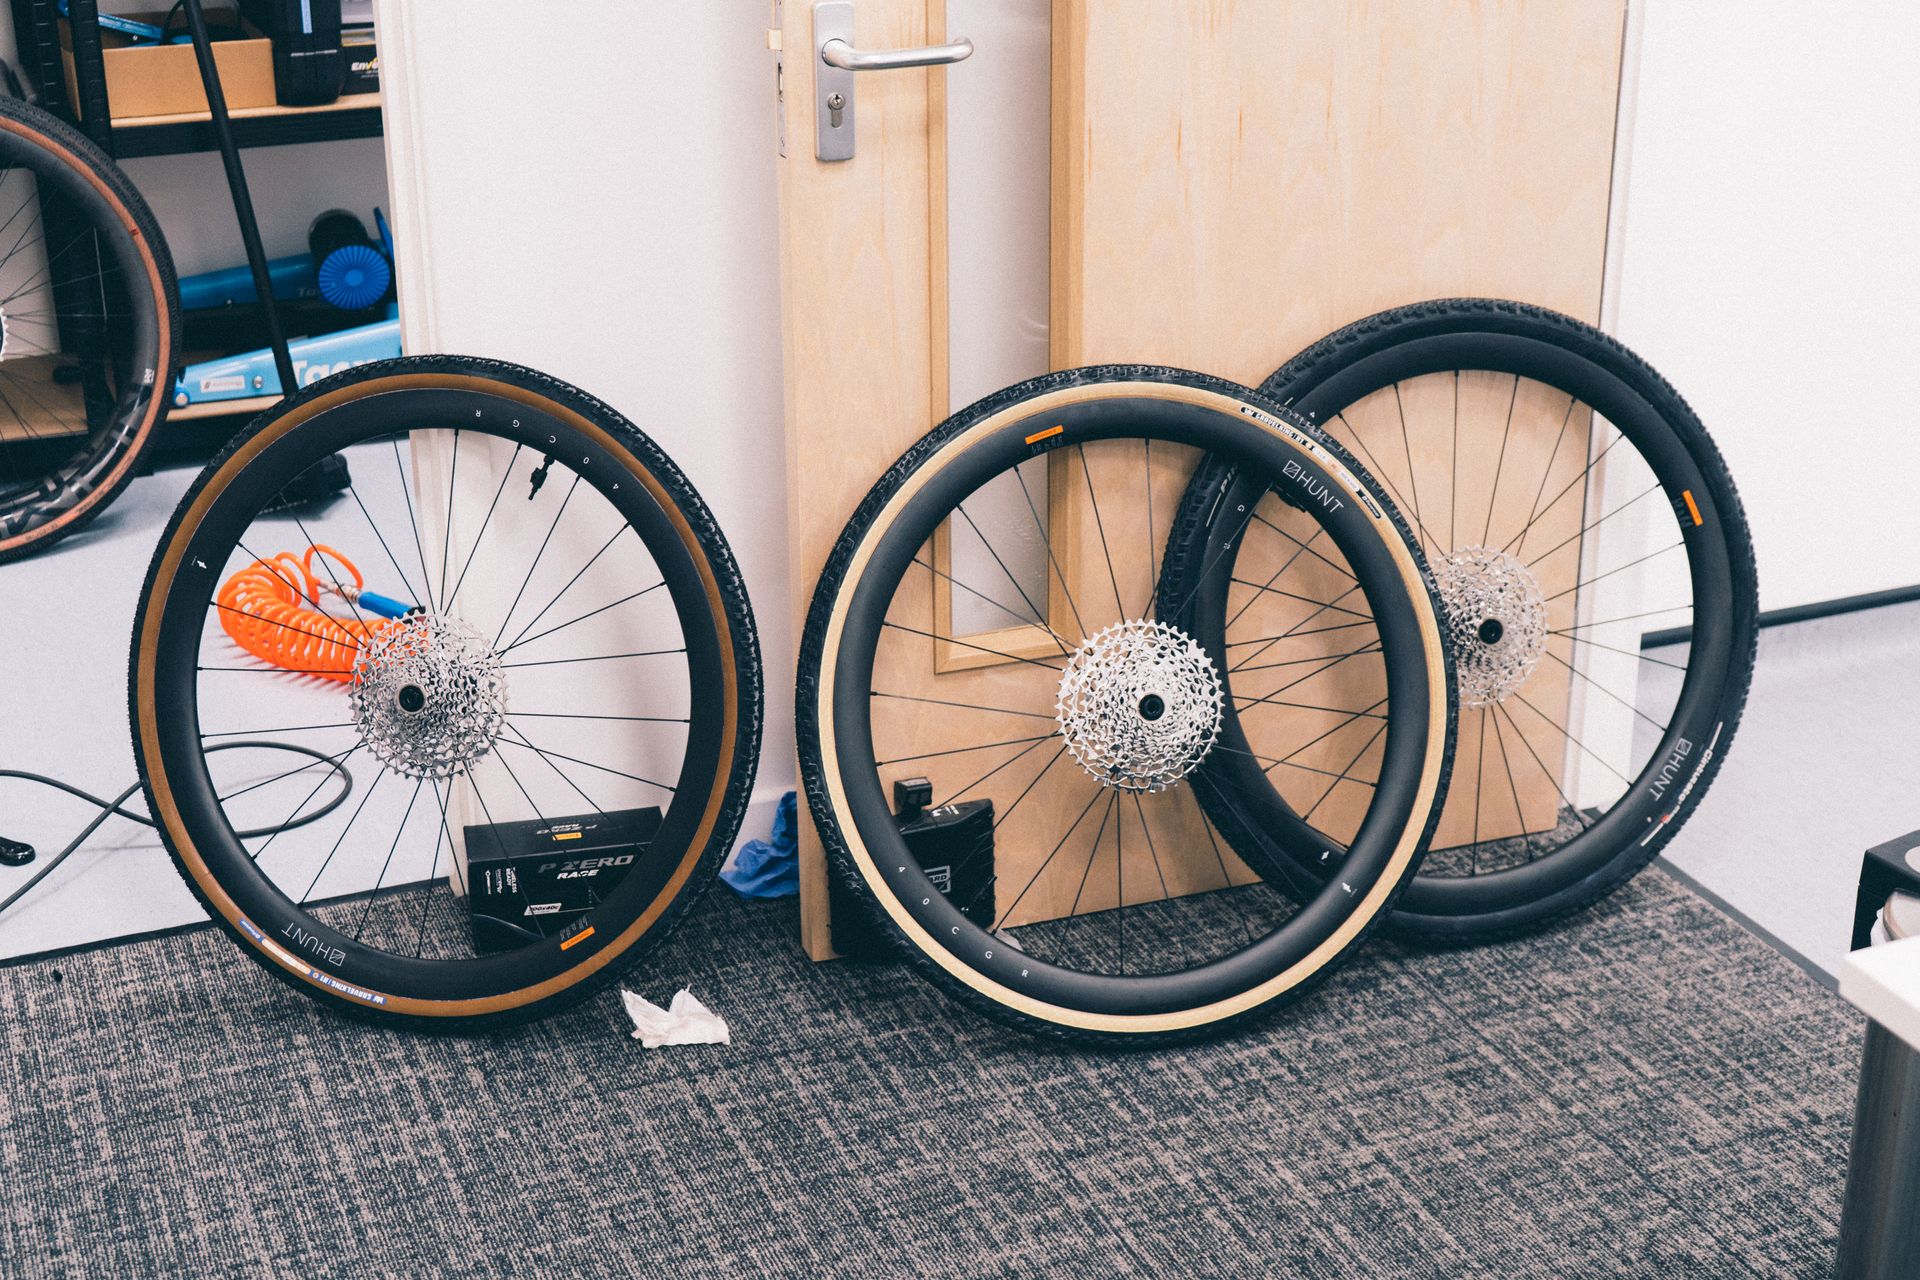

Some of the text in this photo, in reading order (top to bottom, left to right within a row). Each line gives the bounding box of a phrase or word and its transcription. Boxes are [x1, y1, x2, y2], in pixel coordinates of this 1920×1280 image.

[1296, 470, 1345, 513] HUNT
[1649, 753, 1685, 801] HUNT
[538, 855, 634, 873] P ZERO
[557, 869, 600, 879] RACE
[281, 922, 331, 959] HUNT
